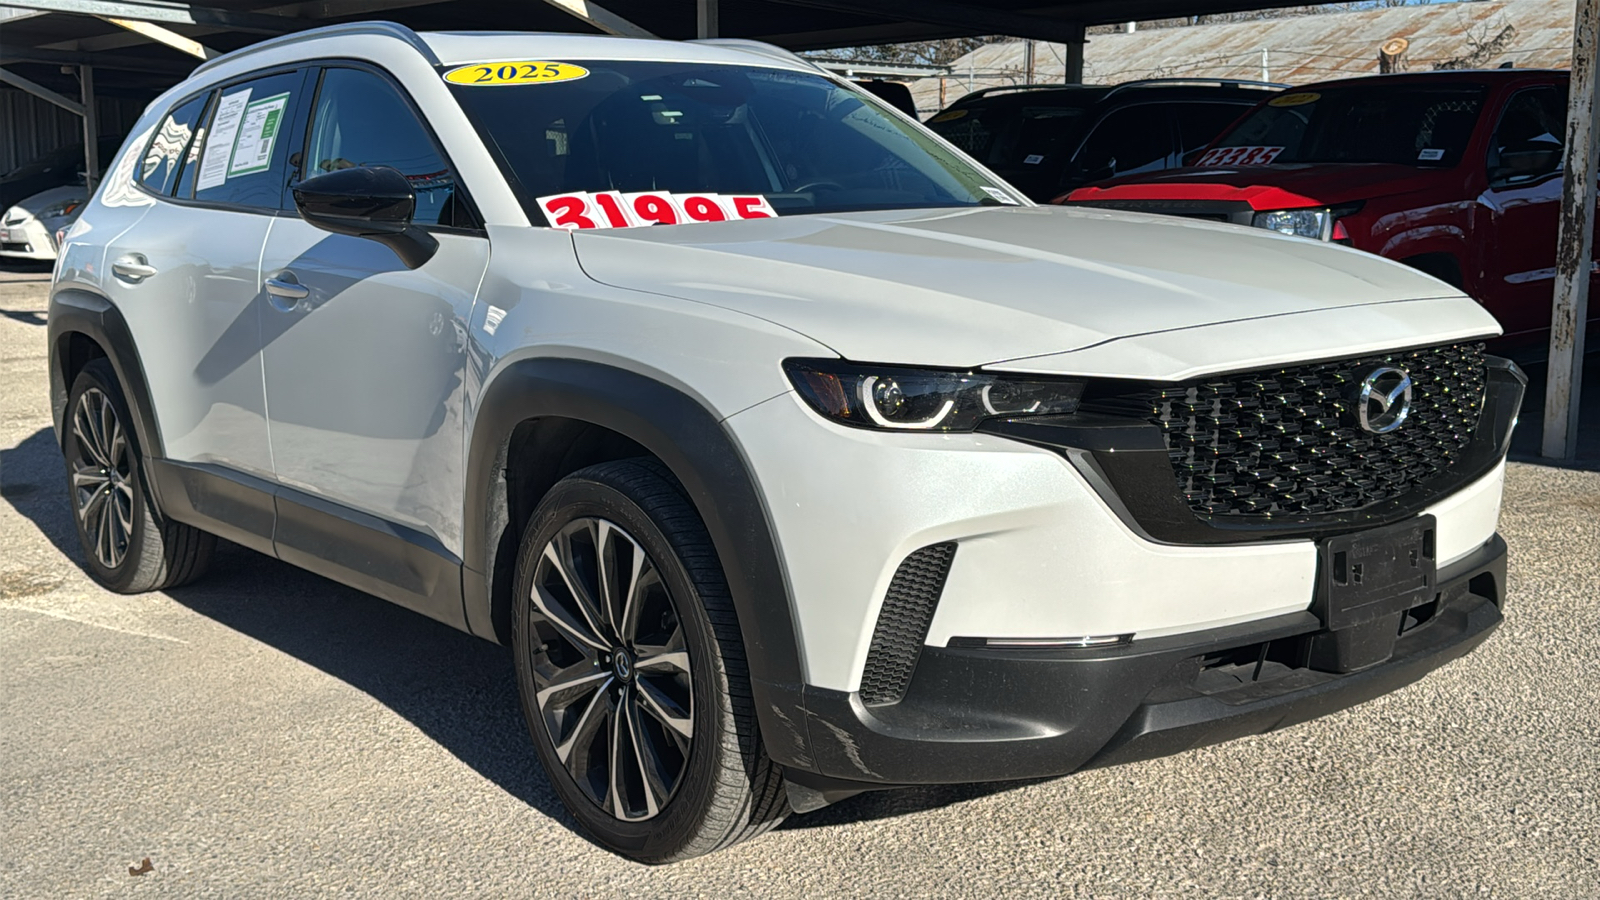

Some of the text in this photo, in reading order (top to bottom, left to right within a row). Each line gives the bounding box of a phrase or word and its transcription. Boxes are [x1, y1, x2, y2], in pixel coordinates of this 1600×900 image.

[474, 64, 559, 82] 2025
[1198, 147, 1282, 167] 23385
[545, 193, 771, 228] 31995
